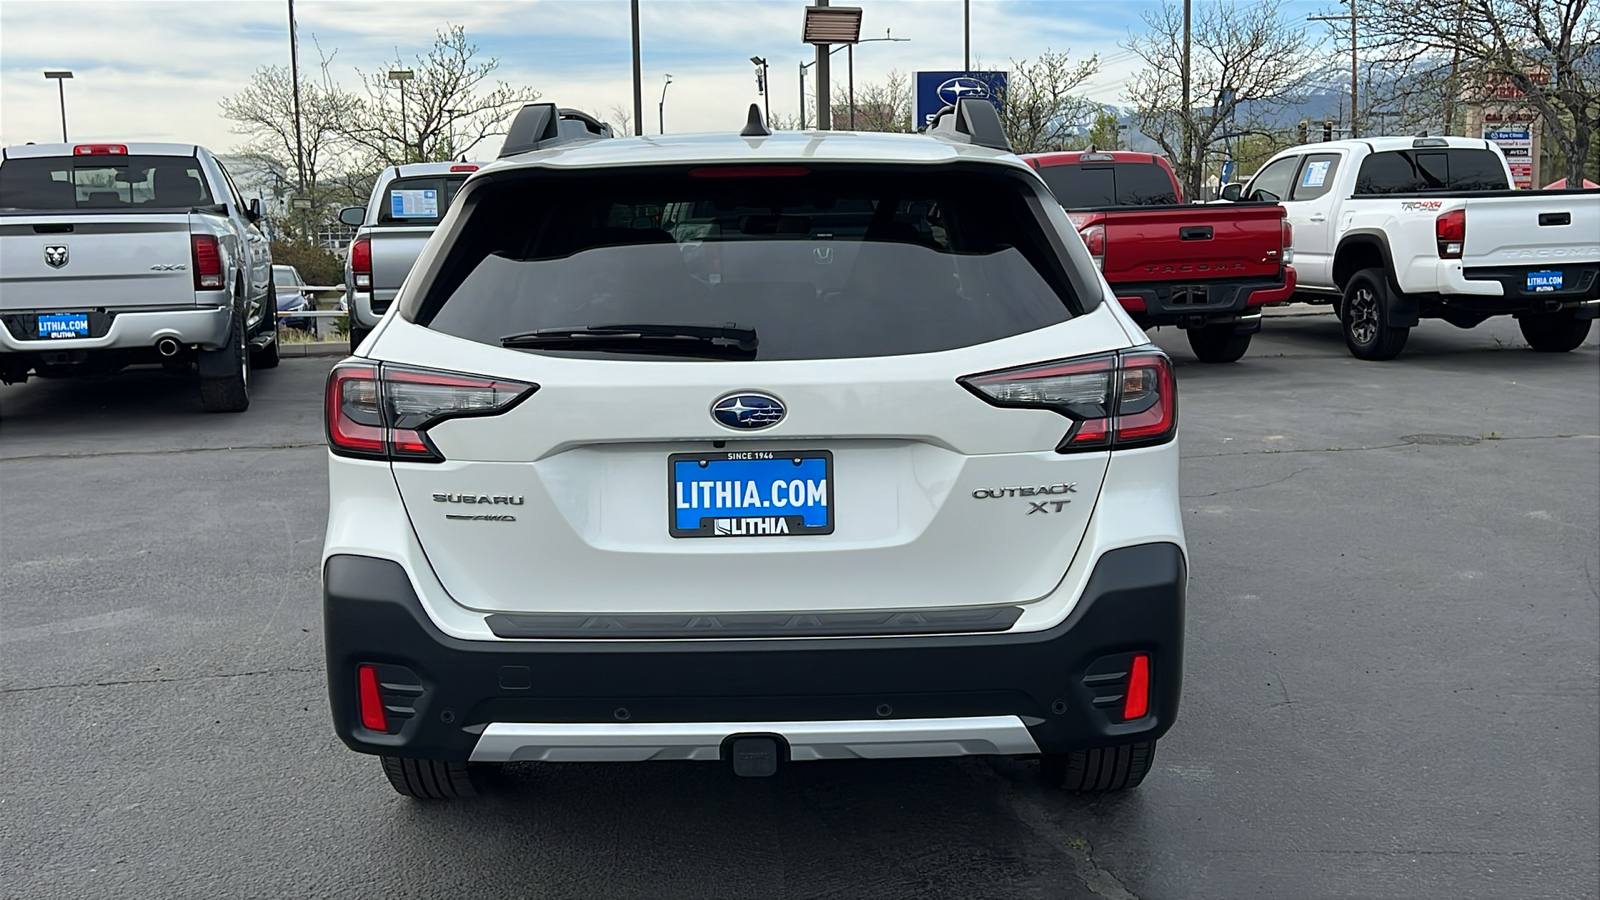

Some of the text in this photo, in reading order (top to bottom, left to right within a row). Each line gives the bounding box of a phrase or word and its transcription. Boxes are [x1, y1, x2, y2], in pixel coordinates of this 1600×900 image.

[1501, 248, 1600, 258] TACOMA
[1143, 263, 1246, 274] TACOMA
[1527, 276, 1562, 286] LITHIA.COM
[39, 320, 88, 331] LITHIA.COM
[727, 452, 752, 460] SINCE
[676, 479, 828, 509] LITHIA.COM
[972, 482, 1078, 499] OUTBACK
[432, 492, 524, 505] SUBARU
[1026, 500, 1071, 515] XT
[472, 514, 516, 522] AWD
[731, 517, 790, 535] LITHIA
